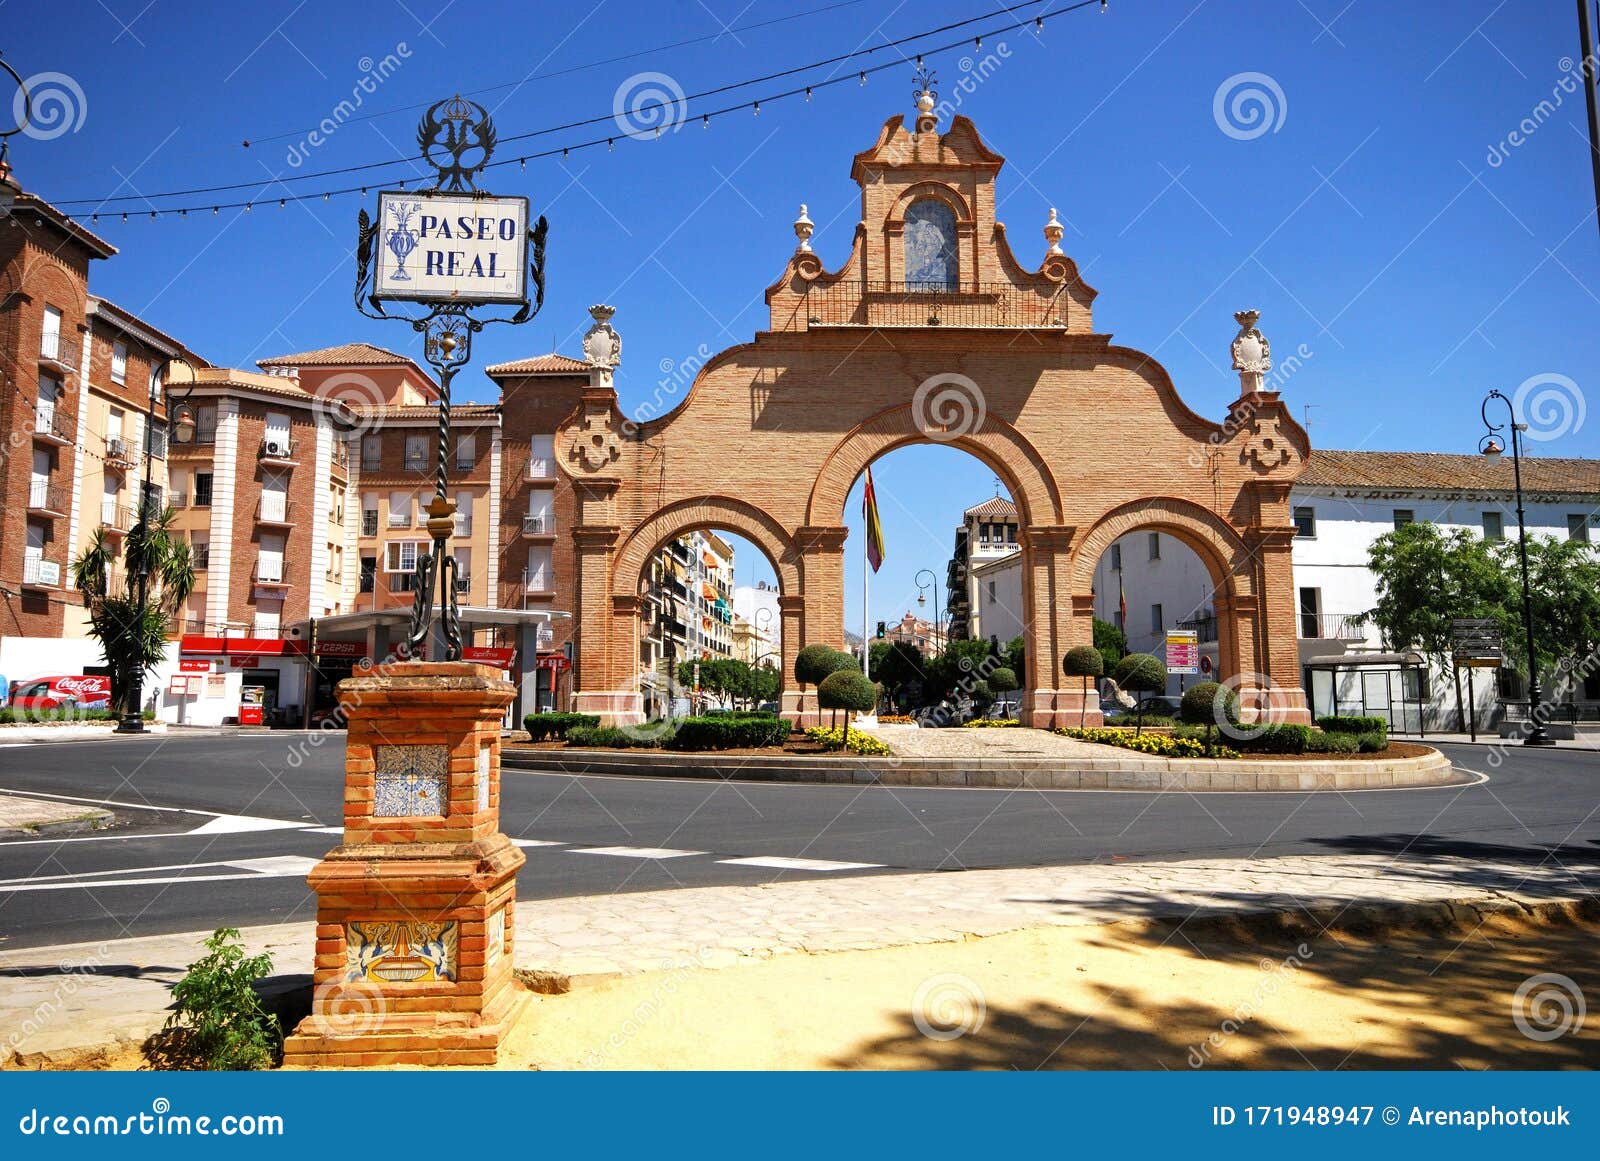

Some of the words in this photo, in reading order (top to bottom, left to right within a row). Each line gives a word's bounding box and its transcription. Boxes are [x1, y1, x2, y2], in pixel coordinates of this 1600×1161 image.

[420, 215, 516, 241] PASEO
[425, 250, 506, 278] REAL
[322, 643, 355, 653] CEPSA
[56, 678, 104, 692] Coca-Cola
